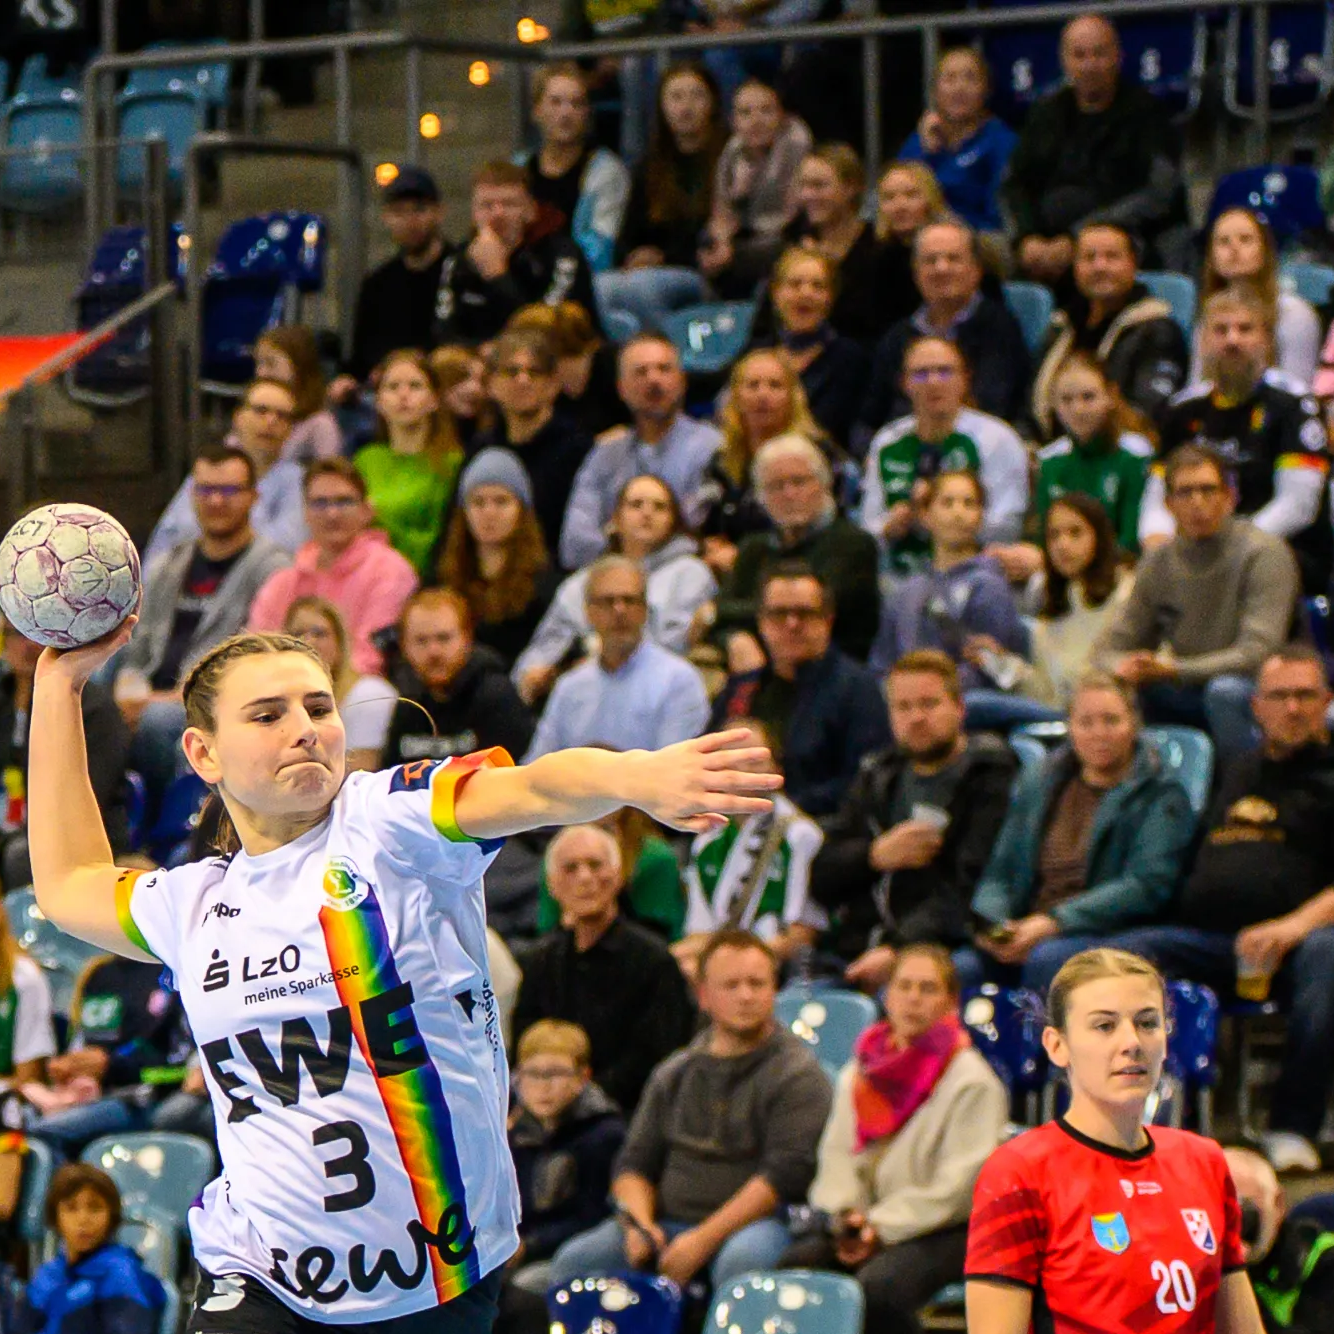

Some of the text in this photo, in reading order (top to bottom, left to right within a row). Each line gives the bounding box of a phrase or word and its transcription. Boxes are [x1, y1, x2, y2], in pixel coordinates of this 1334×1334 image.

[242, 944, 301, 983] LzO
[244, 964, 360, 1005] meine Sparkasse
[201, 980, 429, 1124] EWE
[312, 1120, 377, 1213] 3
[1150, 1259, 1197, 1314] 20
